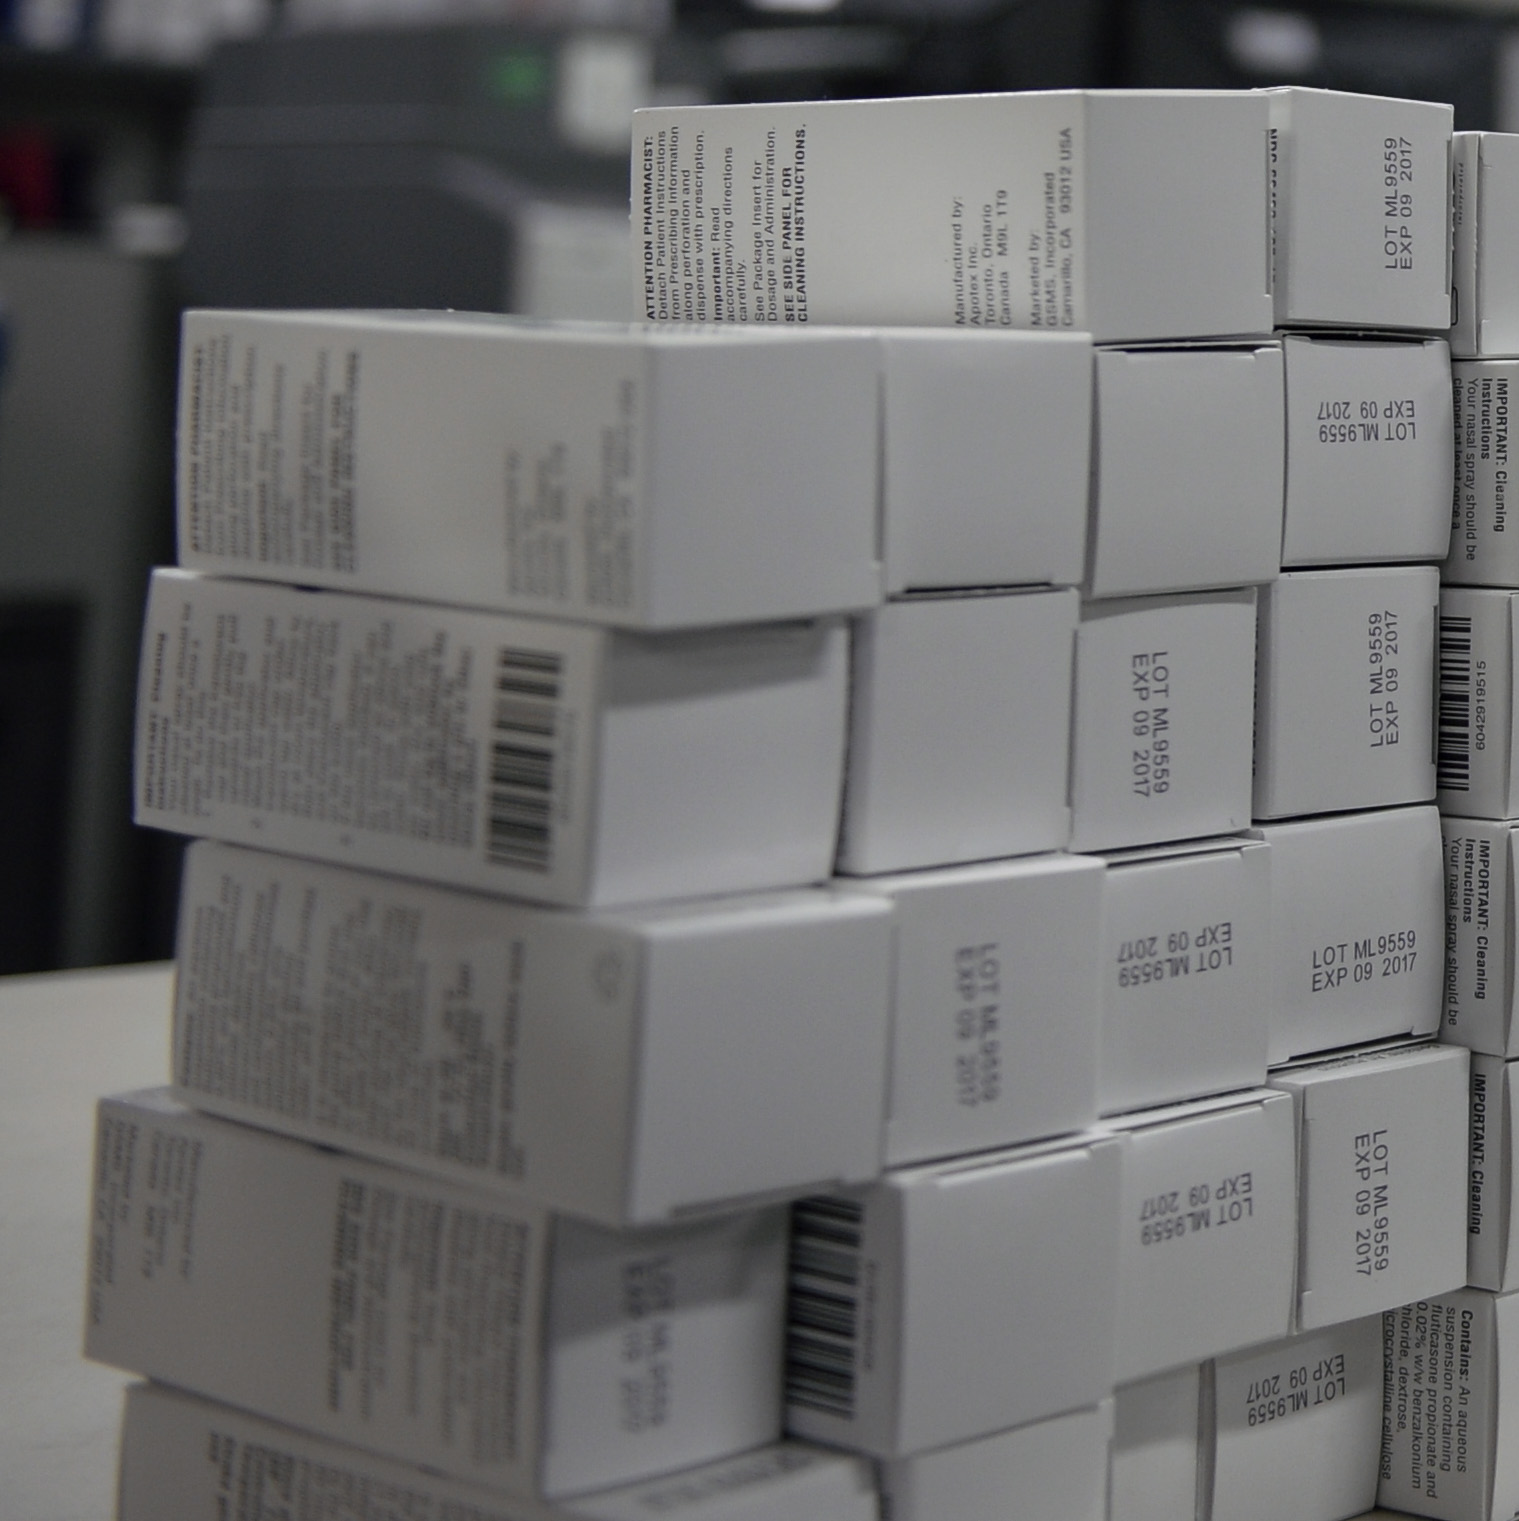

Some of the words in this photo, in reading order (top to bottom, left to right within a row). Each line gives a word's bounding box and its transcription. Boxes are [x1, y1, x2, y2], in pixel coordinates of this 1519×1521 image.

[656, 131, 666, 213] Instructions
[669, 126, 678, 204] Information
[752, 160, 761, 180] for
[765, 127, 776, 234] Administration.
[1384, 138, 1398, 217] ML9559
[1399, 137, 1412, 181] 2017
[644, 136, 653, 235] PHARMACIST:
[681, 169, 690, 195] and
[723, 147, 732, 215] directions
[782, 167, 791, 197] FOR
[795, 124, 806, 241] INSTRUCTIONS.
[711, 207, 720, 241] Read
[752, 186, 762, 225] Insert
[782, 202, 792, 250] PANEL
[1400, 194, 1412, 218] 09
[656, 220, 666, 266] Patient
[669, 209, 678, 284] Prescribing
[681, 200, 692, 277] perforation
[695, 224, 703, 253] with
[765, 240, 775, 264] and
[1384, 226, 1398, 269] LOT
[1400, 226, 1412, 269] EXP
[644, 241, 655, 319] ATTENTION
[723, 221, 735, 321] accompanying
[753, 232, 764, 290] Package
[783, 256, 793, 289] SIDE
[657, 272, 668, 319] Detach
[671, 289, 680, 320] from
[683, 283, 693, 321] along
[697, 258, 707, 321] dispense
[712, 247, 723, 321] Important:
[767, 270, 777, 321] Dosage
[795, 247, 808, 322] CLEANING
[754, 296, 765, 321] See
[784, 295, 794, 321] SEE
[1317, 402, 1351, 420] 2017
[1360, 401, 1377, 419] 09
[1383, 400, 1415, 418] EXP
[1467, 378, 1478, 408] Your
[1319, 423, 1378, 443] ML9559
[1385, 422, 1416, 440] LOT
[1467, 414, 1477, 448] nasal
[1481, 378, 1492, 459] Instructions
[1496, 378, 1507, 465] IMPORTANT:
[1464, 453, 1476, 489] spray
[1466, 495, 1476, 540] should
[1494, 471, 1507, 532] Cleaning
[1467, 545, 1476, 560] be
[1385, 610, 1398, 654] 2017
[1152, 651, 1169, 697] LOT
[1369, 614, 1383, 694] ML9559
[1132, 654, 1149, 701] EXP
[1385, 668, 1398, 692] 09
[1133, 711, 1149, 736] 09
[1370, 704, 1383, 747] LOT
[1386, 701, 1398, 744] EXP
[1476, 661, 1486, 750] 6042919515
[1153, 708, 1169, 793] ML9559
[1133, 750, 1150, 797] 2017
[1451, 838, 1461, 869] Your
[1449, 874, 1459, 909] nasal
[1463, 838, 1476, 923] Instructions
[1477, 840, 1490, 930] IMPORTANT:
[1118, 937, 1157, 963] 2017
[1168, 932, 1189, 953] 09
[1195, 922, 1231, 947] EXP
[1313, 944, 1347, 969] LOT
[1354, 930, 1415, 960] ML9559
[1447, 915, 1457, 953] spray
[1119, 955, 1189, 987] ML9559
[1196, 946, 1232, 972] LOT
[1312, 967, 1347, 992] EXP
[1354, 962, 1372, 982] 09
[1383, 952, 1417, 976] 2017
[1475, 936, 1487, 999] Cleaning
[1448, 957, 1459, 1005] should
[1449, 1009, 1458, 1025] be
[1472, 1074, 1486, 1165] IMPORTANT:
[1355, 1134, 1370, 1180] EXP
[1373, 1130, 1388, 1175] LOT
[1140, 1192, 1179, 1221] 2017
[1190, 1185, 1209, 1207] 09
[1216, 1173, 1252, 1200] EXP
[1356, 1190, 1371, 1215] 09
[1470, 1170, 1484, 1234] Cleaning
[1217, 1197, 1252, 1226] LOT
[1374, 1185, 1389, 1270] ML9559
[1356, 1229, 1371, 1275] 2017
[1415, 1302, 1428, 1348] 0.02%
[1429, 1304, 1442, 1383] fluticasone
[1459, 1310, 1473, 1382] Contains:
[1313, 1354, 1344, 1381] EXP
[1414, 1355, 1424, 1384] w/w
[1444, 1307, 1455, 1390] suspension
[1247, 1375, 1280, 1403] 2017
[1290, 1367, 1307, 1388] 09
[1314, 1378, 1345, 1405] LOT
[1459, 1386, 1470, 1405] An
[1248, 1390, 1307, 1426] ML9559
[1426, 1388, 1439, 1466] propionate
[1383, 1417, 1393, 1480] cellulose
[1412, 1389, 1424, 1489] benzalkonium
[1440, 1396, 1453, 1472] containing
[1457, 1410, 1468, 1472] aqueous
[1426, 1471, 1437, 1499] and
